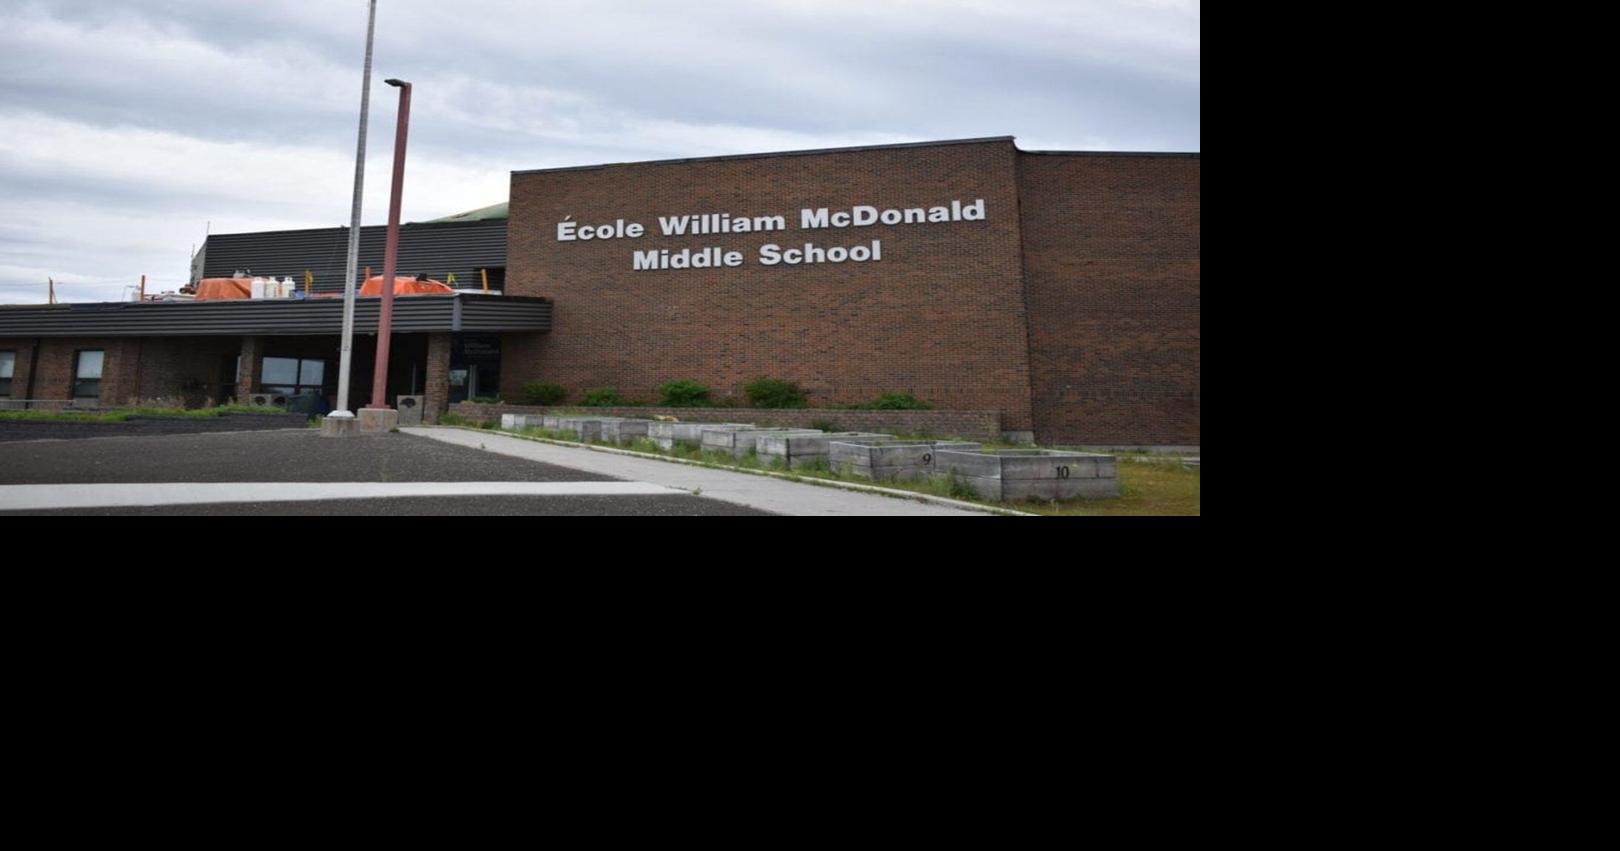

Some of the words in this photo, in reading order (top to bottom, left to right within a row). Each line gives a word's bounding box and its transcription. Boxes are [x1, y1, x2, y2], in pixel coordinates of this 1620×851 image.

[557, 215, 644, 241] École
[658, 212, 786, 236] William
[800, 199, 985, 229] McDonald
[632, 247, 744, 270] Middle
[759, 240, 882, 267] School
[922, 453, 931, 465] 9
[1056, 466, 1070, 479] 10
